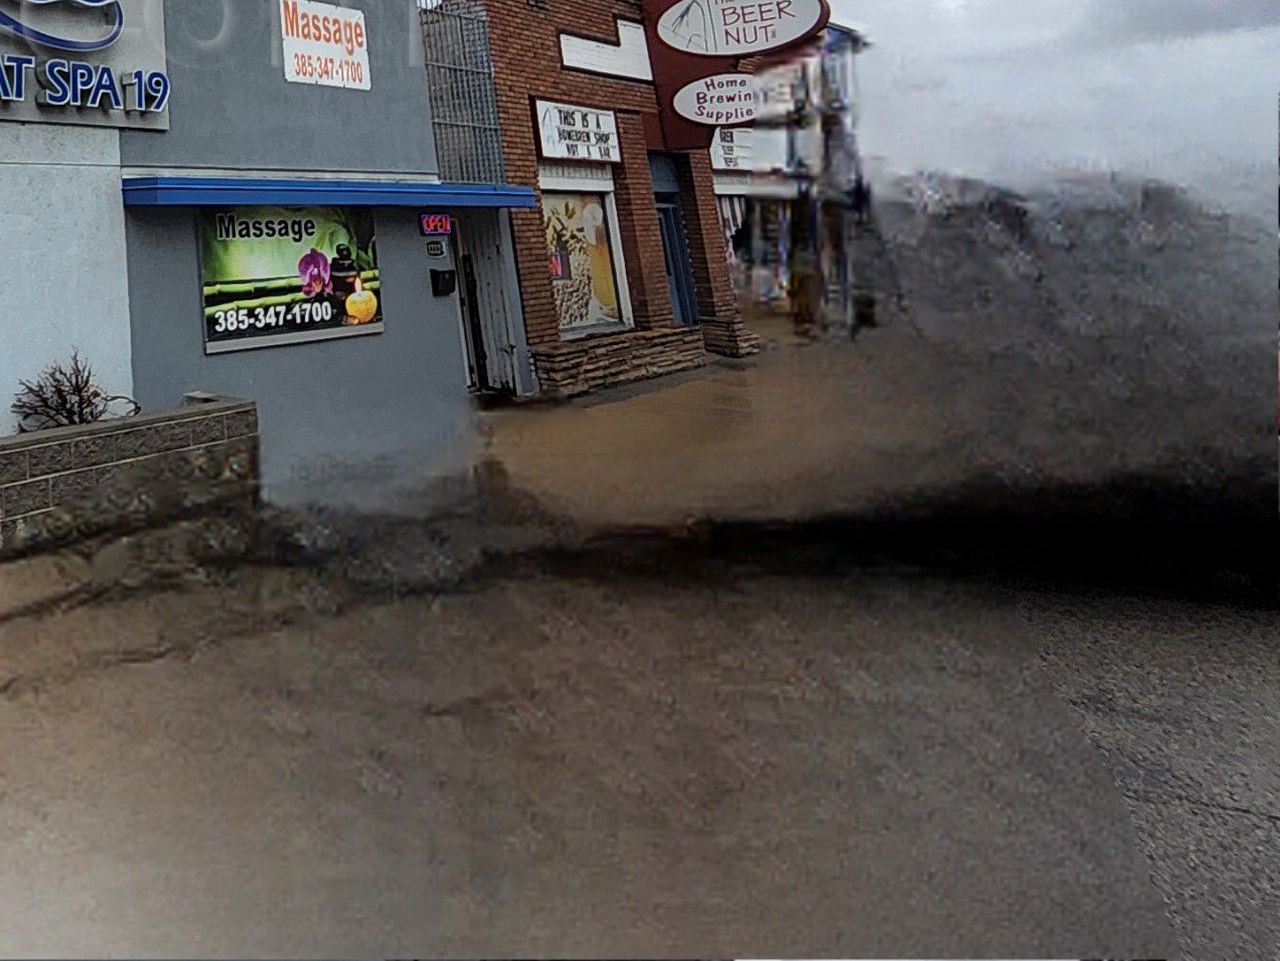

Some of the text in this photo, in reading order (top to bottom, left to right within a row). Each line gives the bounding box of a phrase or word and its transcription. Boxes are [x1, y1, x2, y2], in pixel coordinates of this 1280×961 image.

[721, 0, 796, 26] BEER
[283, 0, 364, 56] Massage
[724, 25, 774, 46] NUT
[294, 52, 363, 83] 385-347-1700
[44, 59, 122, 110] SPA
[133, 70, 169, 112] 19
[704, 78, 747, 92] Home
[696, 90, 754, 105] Brewin
[557, 109, 576, 127] THIS
[581, 112, 589, 128] IS
[694, 105, 754, 122] Supplie
[216, 213, 317, 244] Massage
[423, 217, 451, 233] OPEN
[214, 301, 333, 332] 385-347-1700
